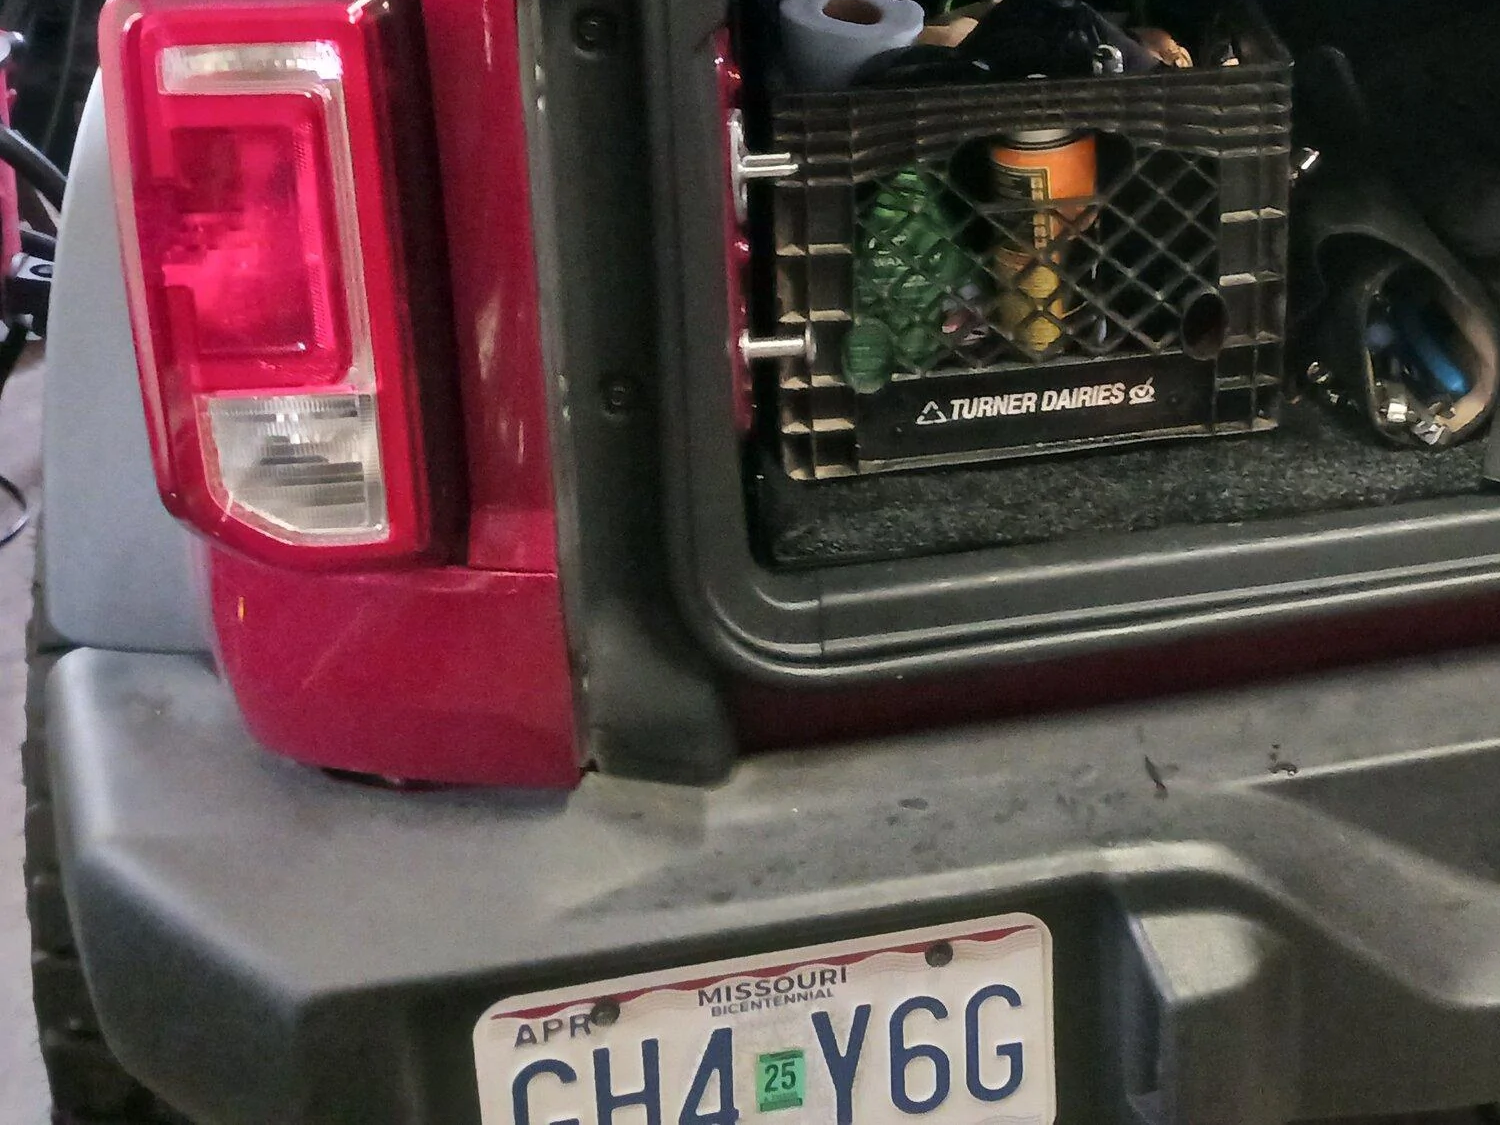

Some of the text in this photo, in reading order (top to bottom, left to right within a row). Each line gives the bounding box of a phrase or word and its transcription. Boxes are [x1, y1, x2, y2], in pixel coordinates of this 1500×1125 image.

[950, 382, 1125, 421] TURNER DAIRIES
[698, 967, 847, 1007] MISSOURI
[711, 988, 834, 1017] BICENTENNIAL
[514, 1012, 593, 1047] APR
[512, 984, 1024, 1125] GH4 Y6G
[764, 1060, 797, 1093] 25
